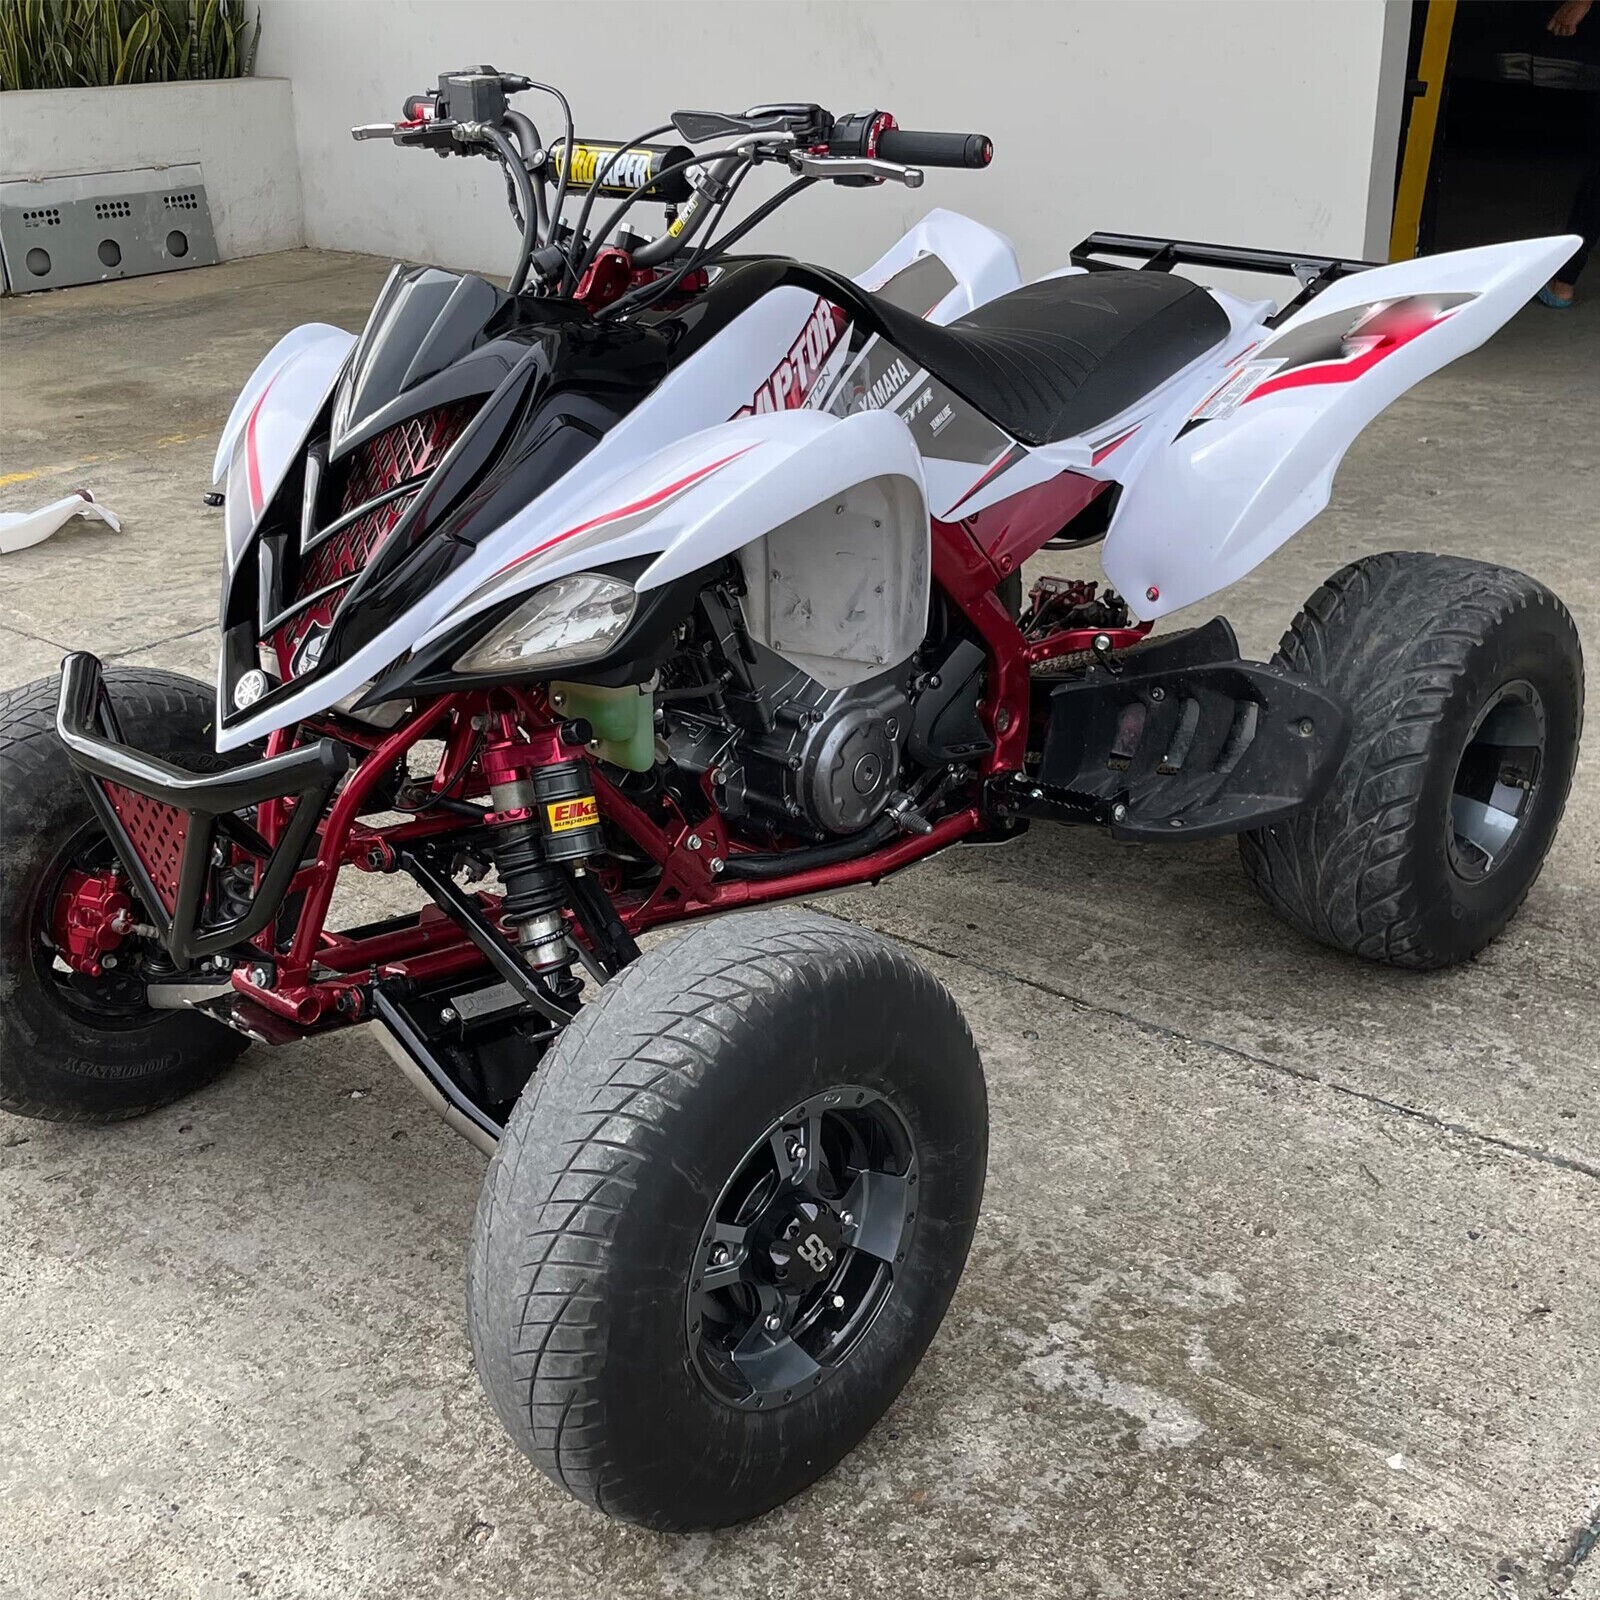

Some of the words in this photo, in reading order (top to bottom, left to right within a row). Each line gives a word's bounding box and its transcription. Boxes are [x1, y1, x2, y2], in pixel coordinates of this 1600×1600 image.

[560, 149, 648, 188] ROTAPER
[728, 296, 837, 420] APTOR
[858, 358, 911, 411] YAMAHA
[797, 1233, 834, 1272] SS
